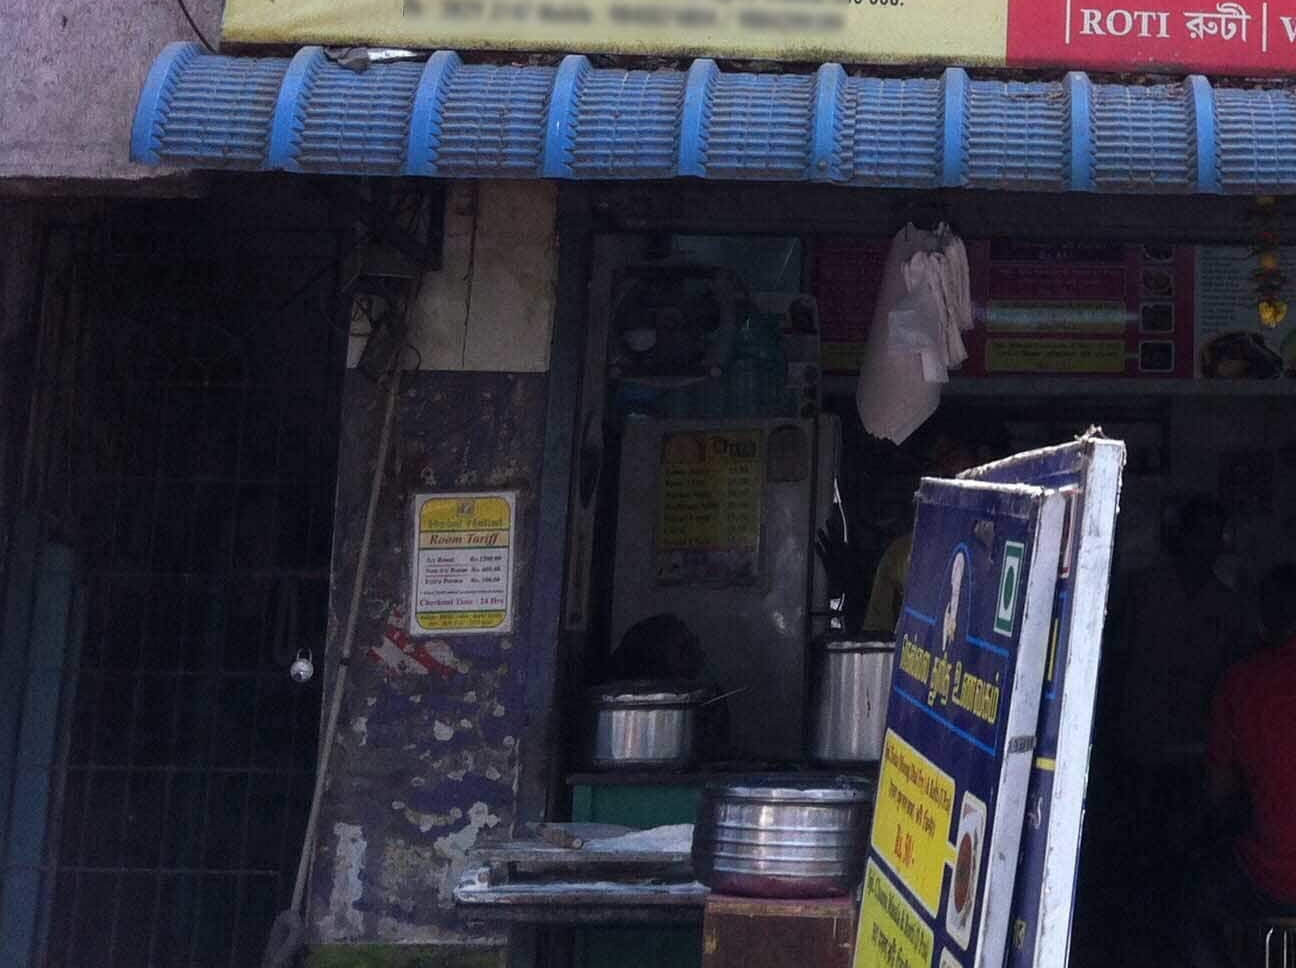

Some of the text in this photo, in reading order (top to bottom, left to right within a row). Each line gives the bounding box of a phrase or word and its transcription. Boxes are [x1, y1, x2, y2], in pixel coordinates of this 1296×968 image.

[1080, 7, 1171, 39] ROTI
[430, 533, 500, 546] Room Tariff
